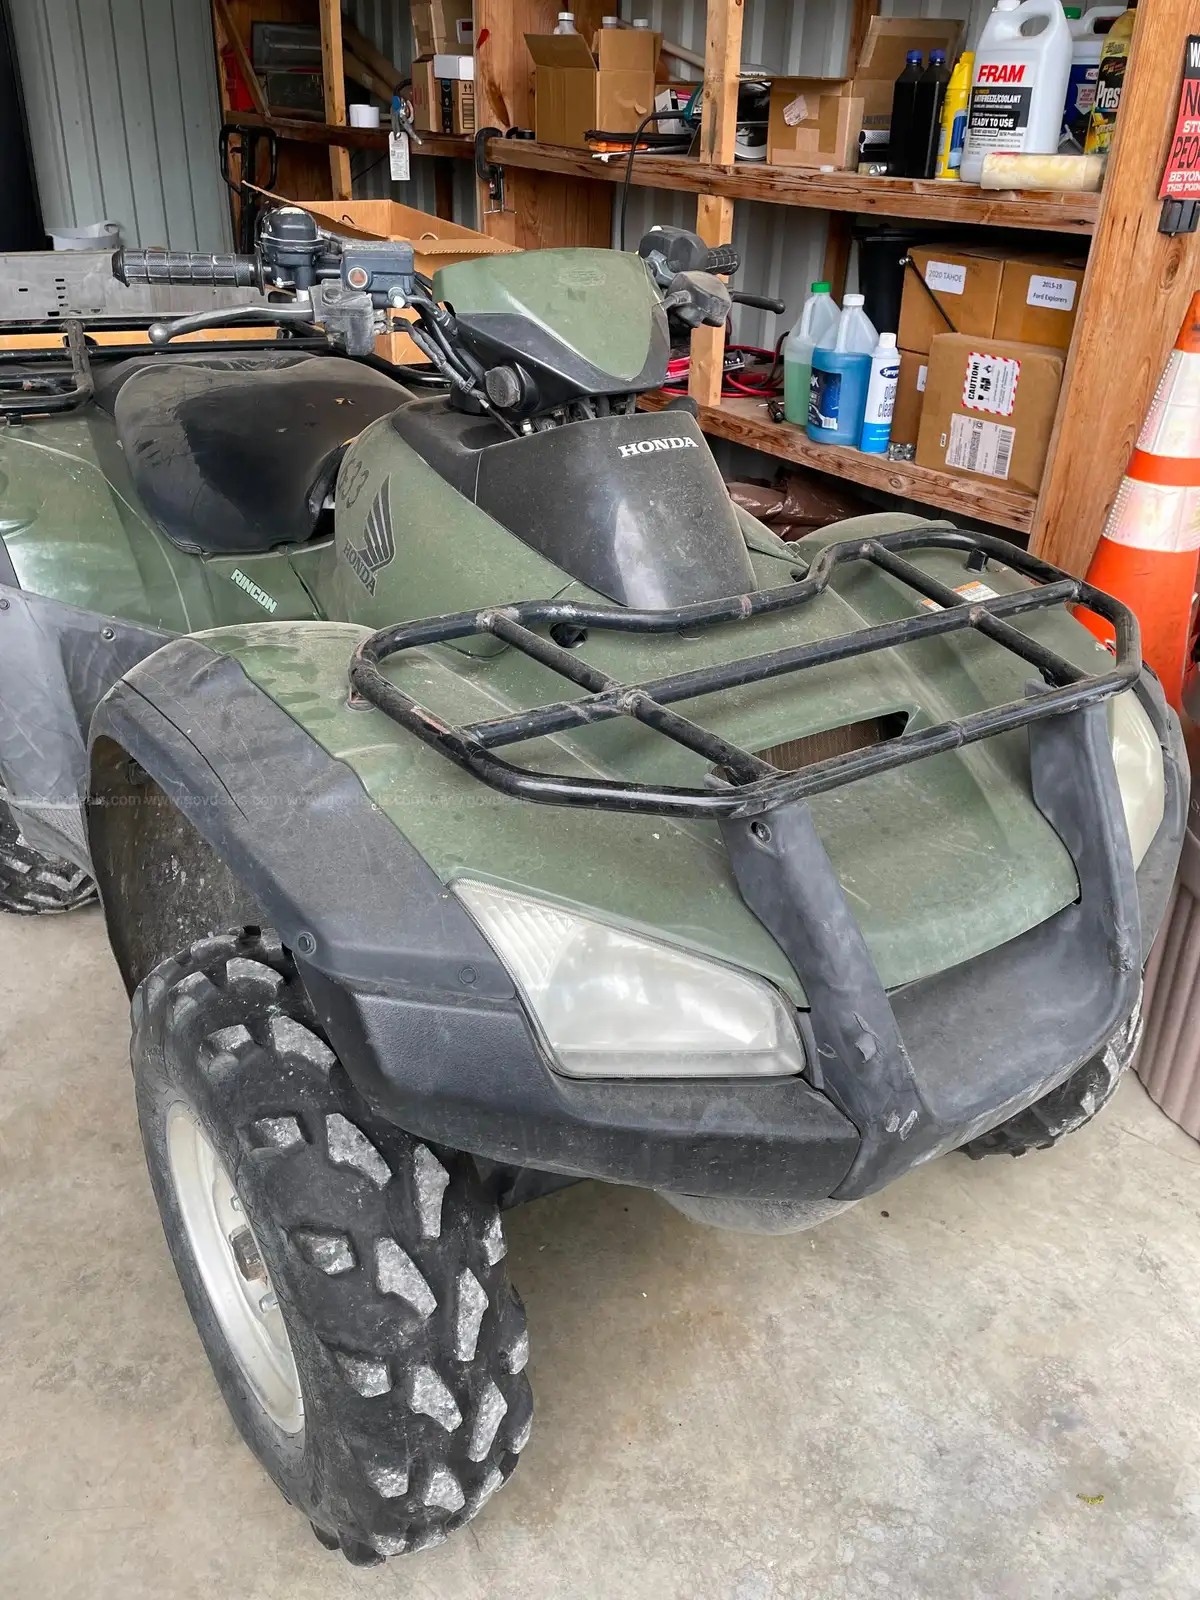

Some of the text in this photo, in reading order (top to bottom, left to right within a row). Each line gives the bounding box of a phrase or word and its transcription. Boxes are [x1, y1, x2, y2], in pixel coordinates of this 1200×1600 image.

[977, 64, 1026, 83] FRAM
[1182, 81, 1200, 117] N
[971, 117, 1015, 128] READY TO USE
[1166, 183, 1184, 192] THIS
[928, 270, 963, 283] 2020 TAHOE
[1032, 292, 1068, 304] Ford Explorers
[968, 361, 981, 400] CAUTION!
[617, 436, 699, 458] HONDA
[343, 540, 377, 597] HONDA
[230, 568, 278, 614] RINCON
